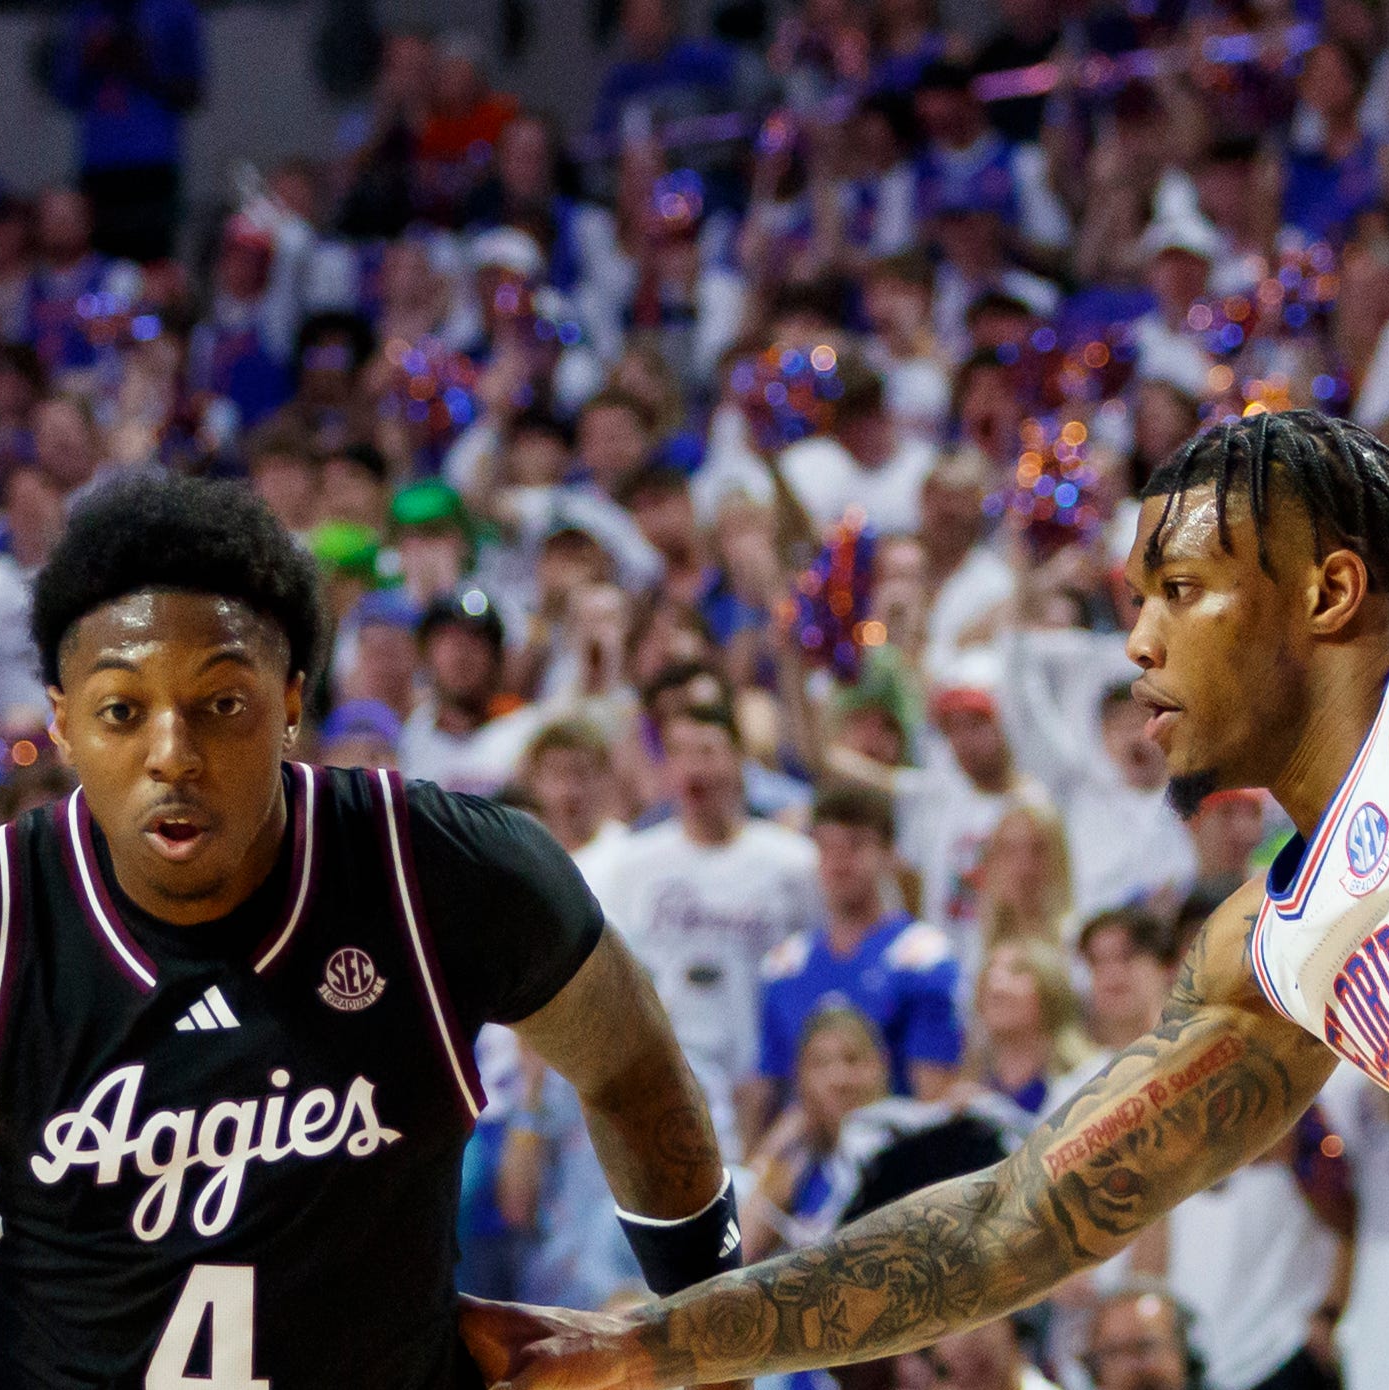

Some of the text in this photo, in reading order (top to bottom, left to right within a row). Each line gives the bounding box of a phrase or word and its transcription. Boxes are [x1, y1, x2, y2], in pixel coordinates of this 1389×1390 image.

[1348, 804, 1387, 874] SEC
[328, 949, 373, 995] SEC
[30, 1063, 403, 1241] Aggies
